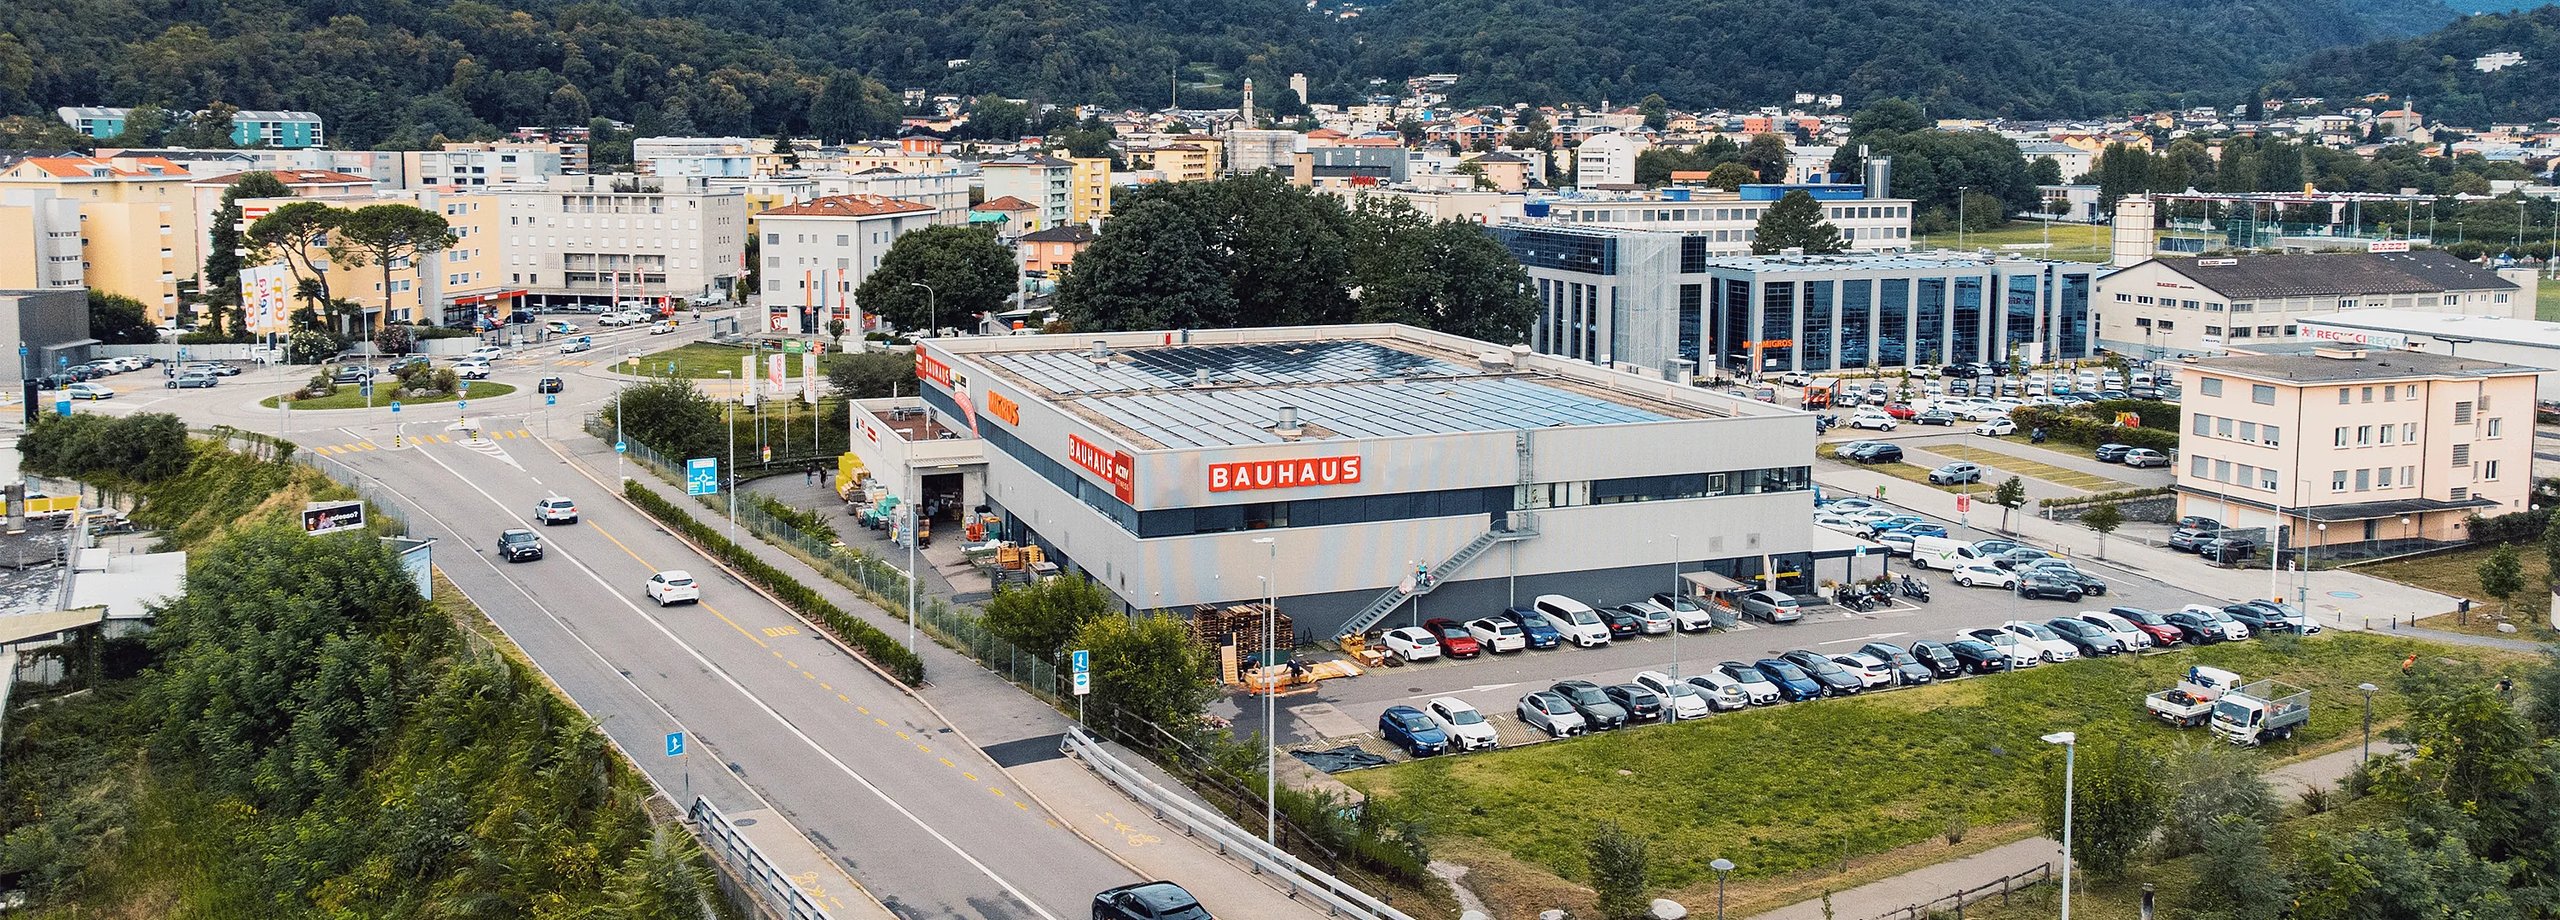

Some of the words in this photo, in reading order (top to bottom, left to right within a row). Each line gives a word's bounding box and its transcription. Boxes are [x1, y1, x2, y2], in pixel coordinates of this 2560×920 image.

[2372, 242, 2406, 250] BAZZI
[273, 277, 285, 321] coop
[1762, 339, 1793, 348] MIGROS
[987, 390, 1019, 427] MIGROS
[1069, 438, 1113, 478] BAUHAUS
[1115, 463, 1129, 480] ACTIV
[1213, 458, 1359, 488] BAUHAUS
[762, 626, 800, 637] BUS
